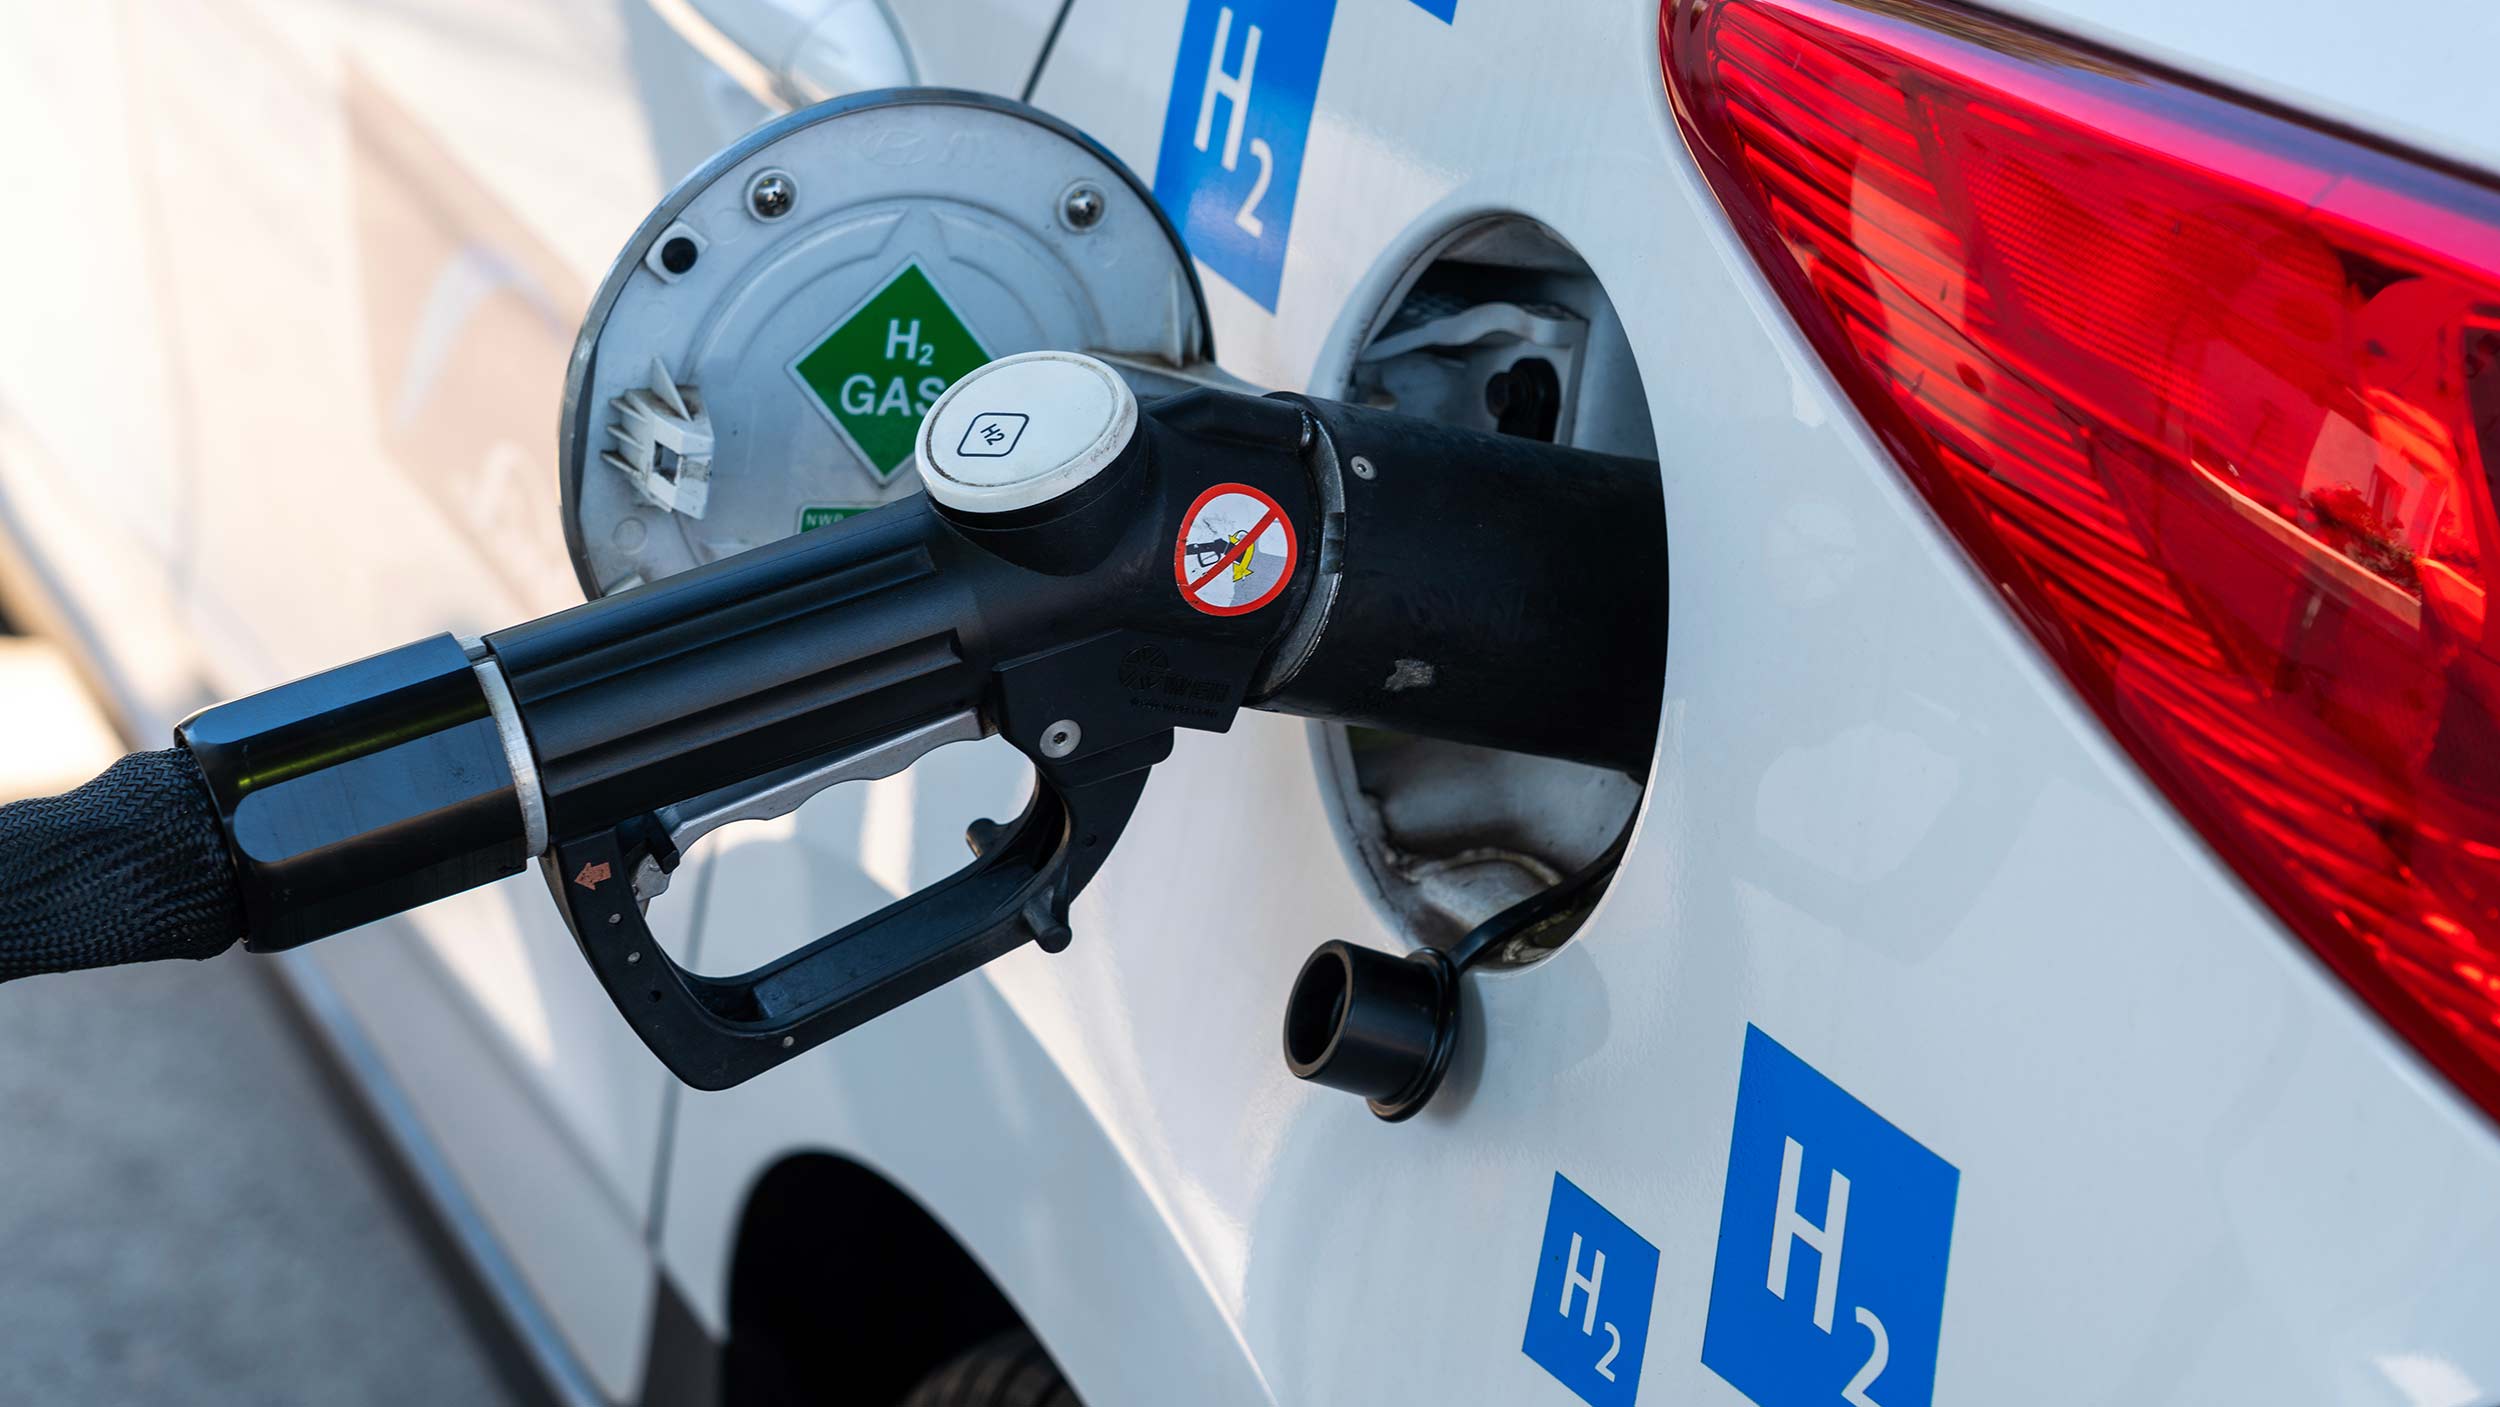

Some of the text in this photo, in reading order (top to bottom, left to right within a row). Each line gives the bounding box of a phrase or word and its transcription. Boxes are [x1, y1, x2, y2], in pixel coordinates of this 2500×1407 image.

[1194, 6, 1273, 238] H2
[885, 319, 935, 366] H2
[841, 373, 946, 416] GAS
[980, 423, 1006, 446] H2
[1559, 1231, 1621, 1383] H2
